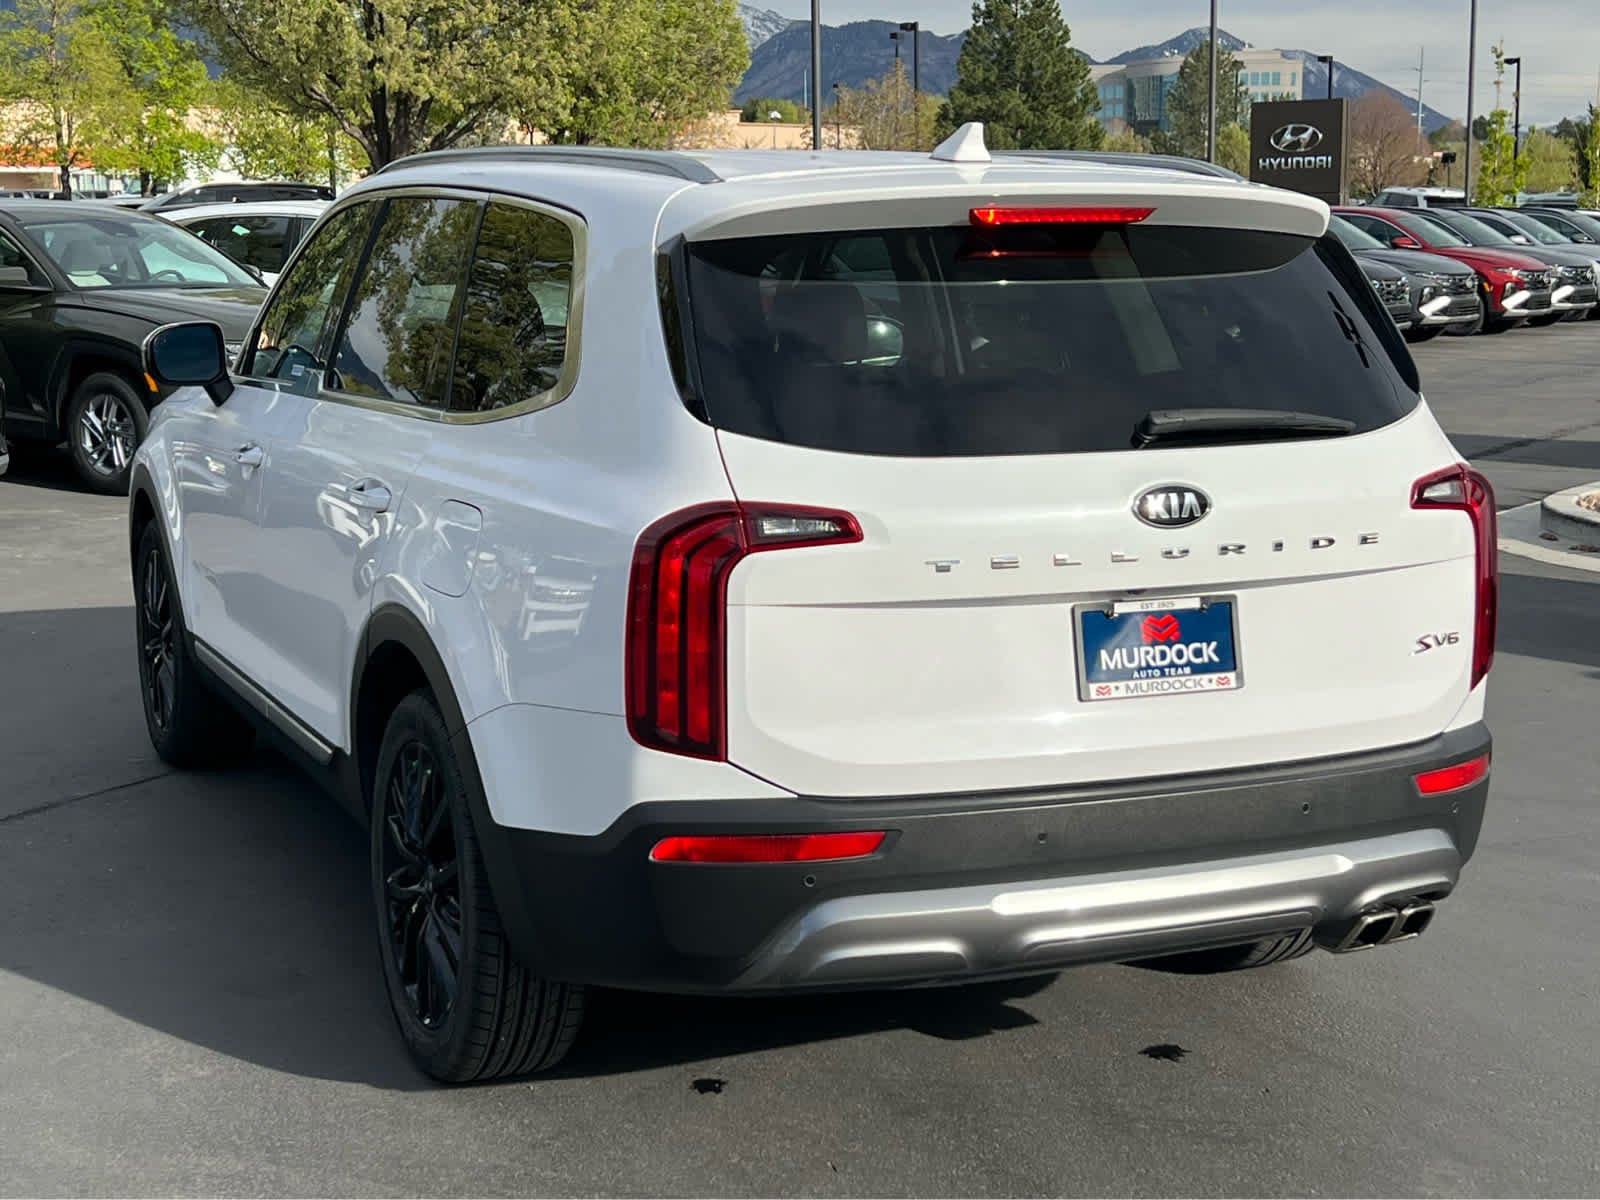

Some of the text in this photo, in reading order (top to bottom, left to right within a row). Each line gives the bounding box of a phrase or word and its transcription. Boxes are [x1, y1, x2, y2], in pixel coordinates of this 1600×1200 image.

[1258, 155, 1333, 170] HYUNDAI
[1145, 492, 1201, 519] KIA
[924, 532, 1379, 573] TELLURIDE
[1100, 641, 1220, 671] MURDOCK
[1133, 666, 1191, 679] AUTO TEAM
[1125, 678, 1205, 695] MURDOCK
